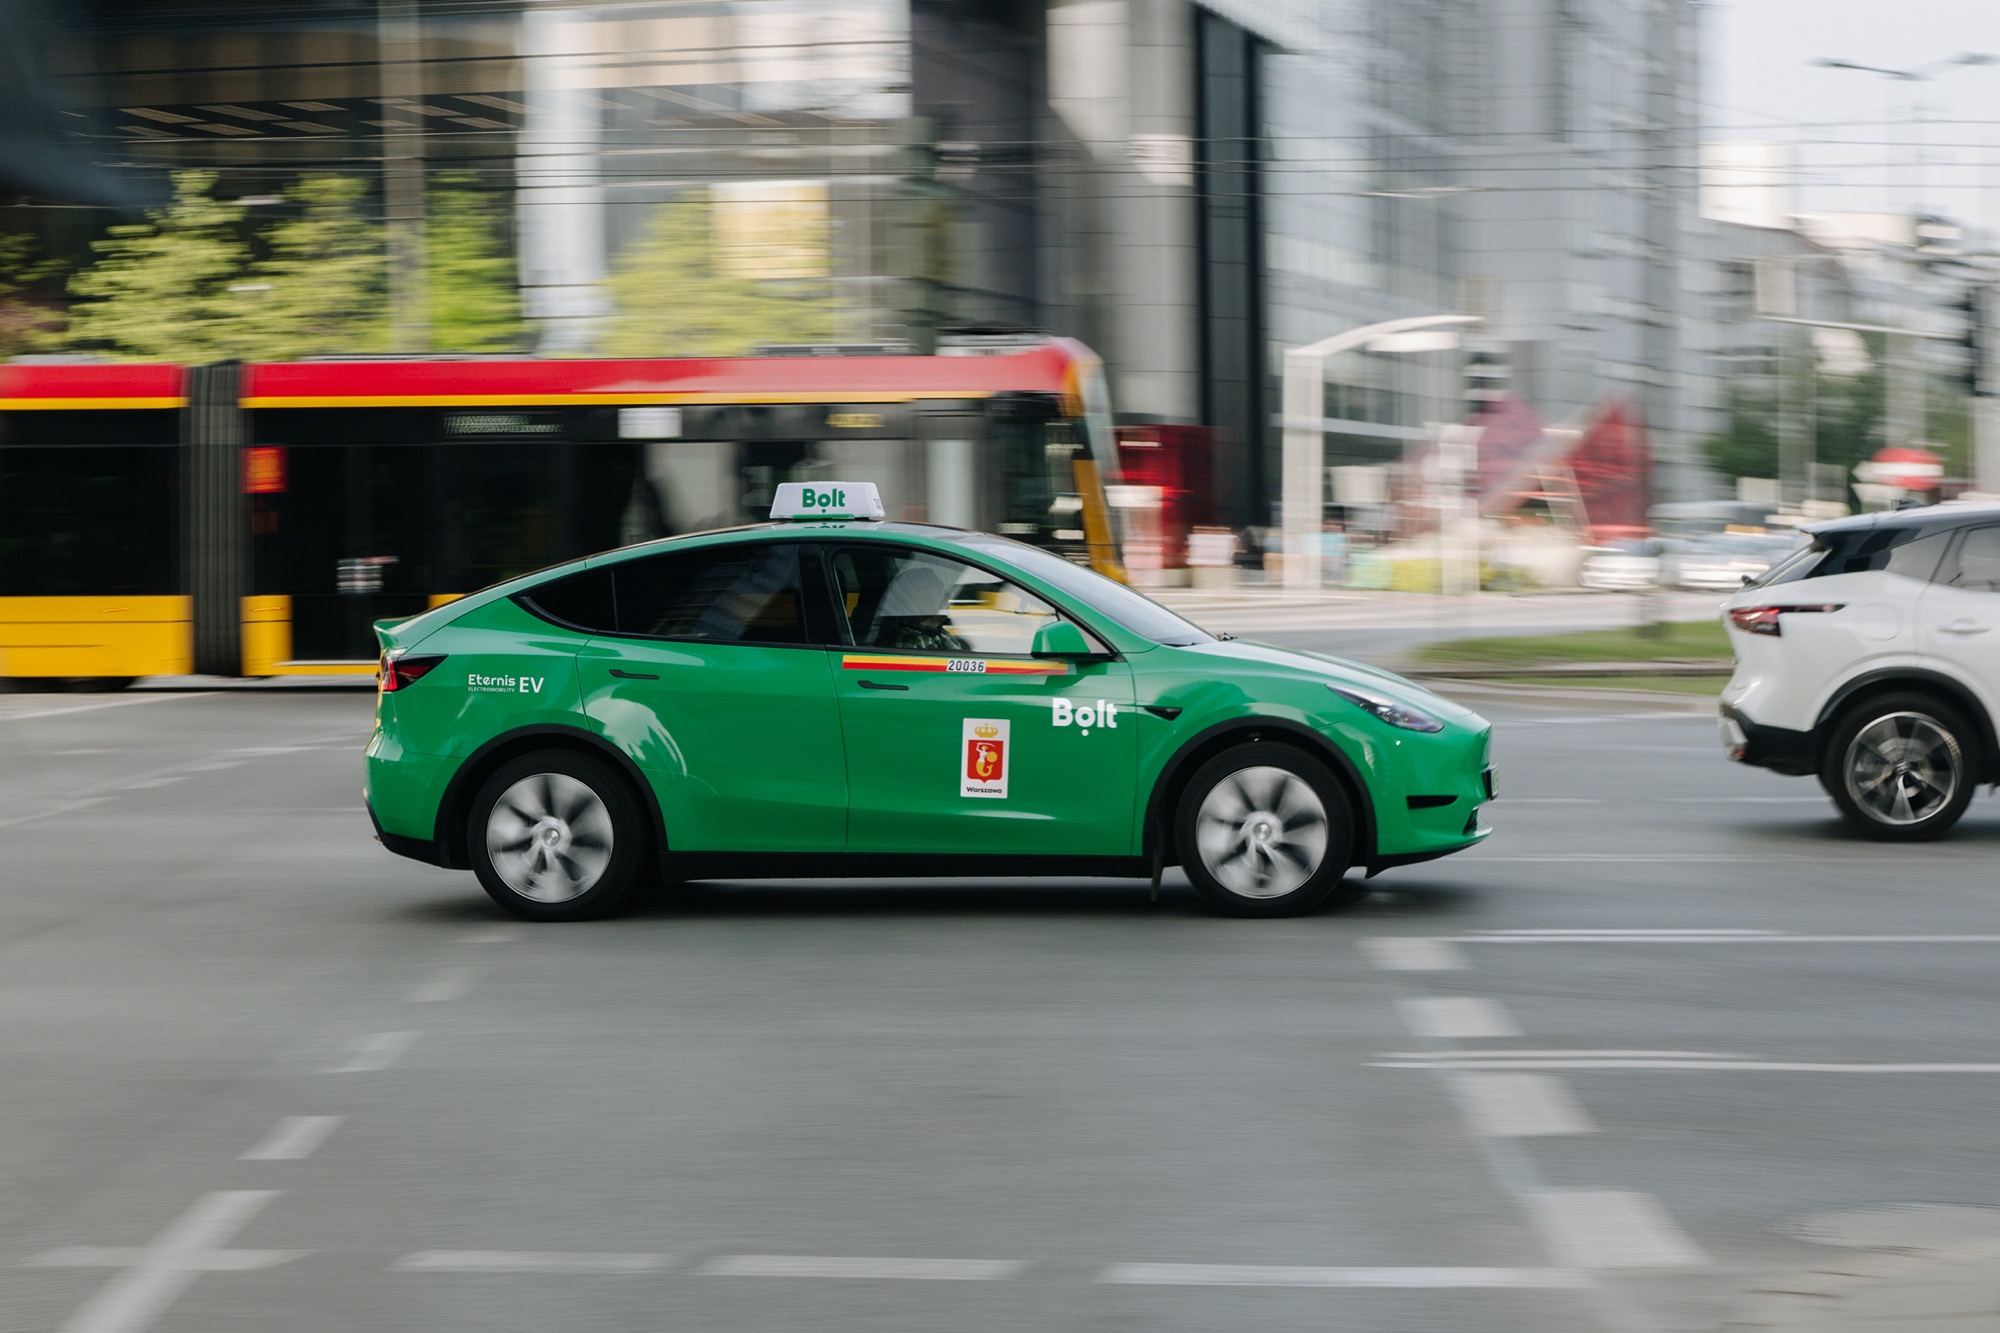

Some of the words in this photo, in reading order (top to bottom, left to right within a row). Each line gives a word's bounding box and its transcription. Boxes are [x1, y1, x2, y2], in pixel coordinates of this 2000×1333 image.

[802, 488, 846, 513] Bolt
[948, 660, 985, 672] 20036
[468, 674, 516, 687] Eternis
[519, 677, 544, 693] EV
[1052, 697, 1118, 737] Bolt
[966, 786, 1003, 794] Warszawa
